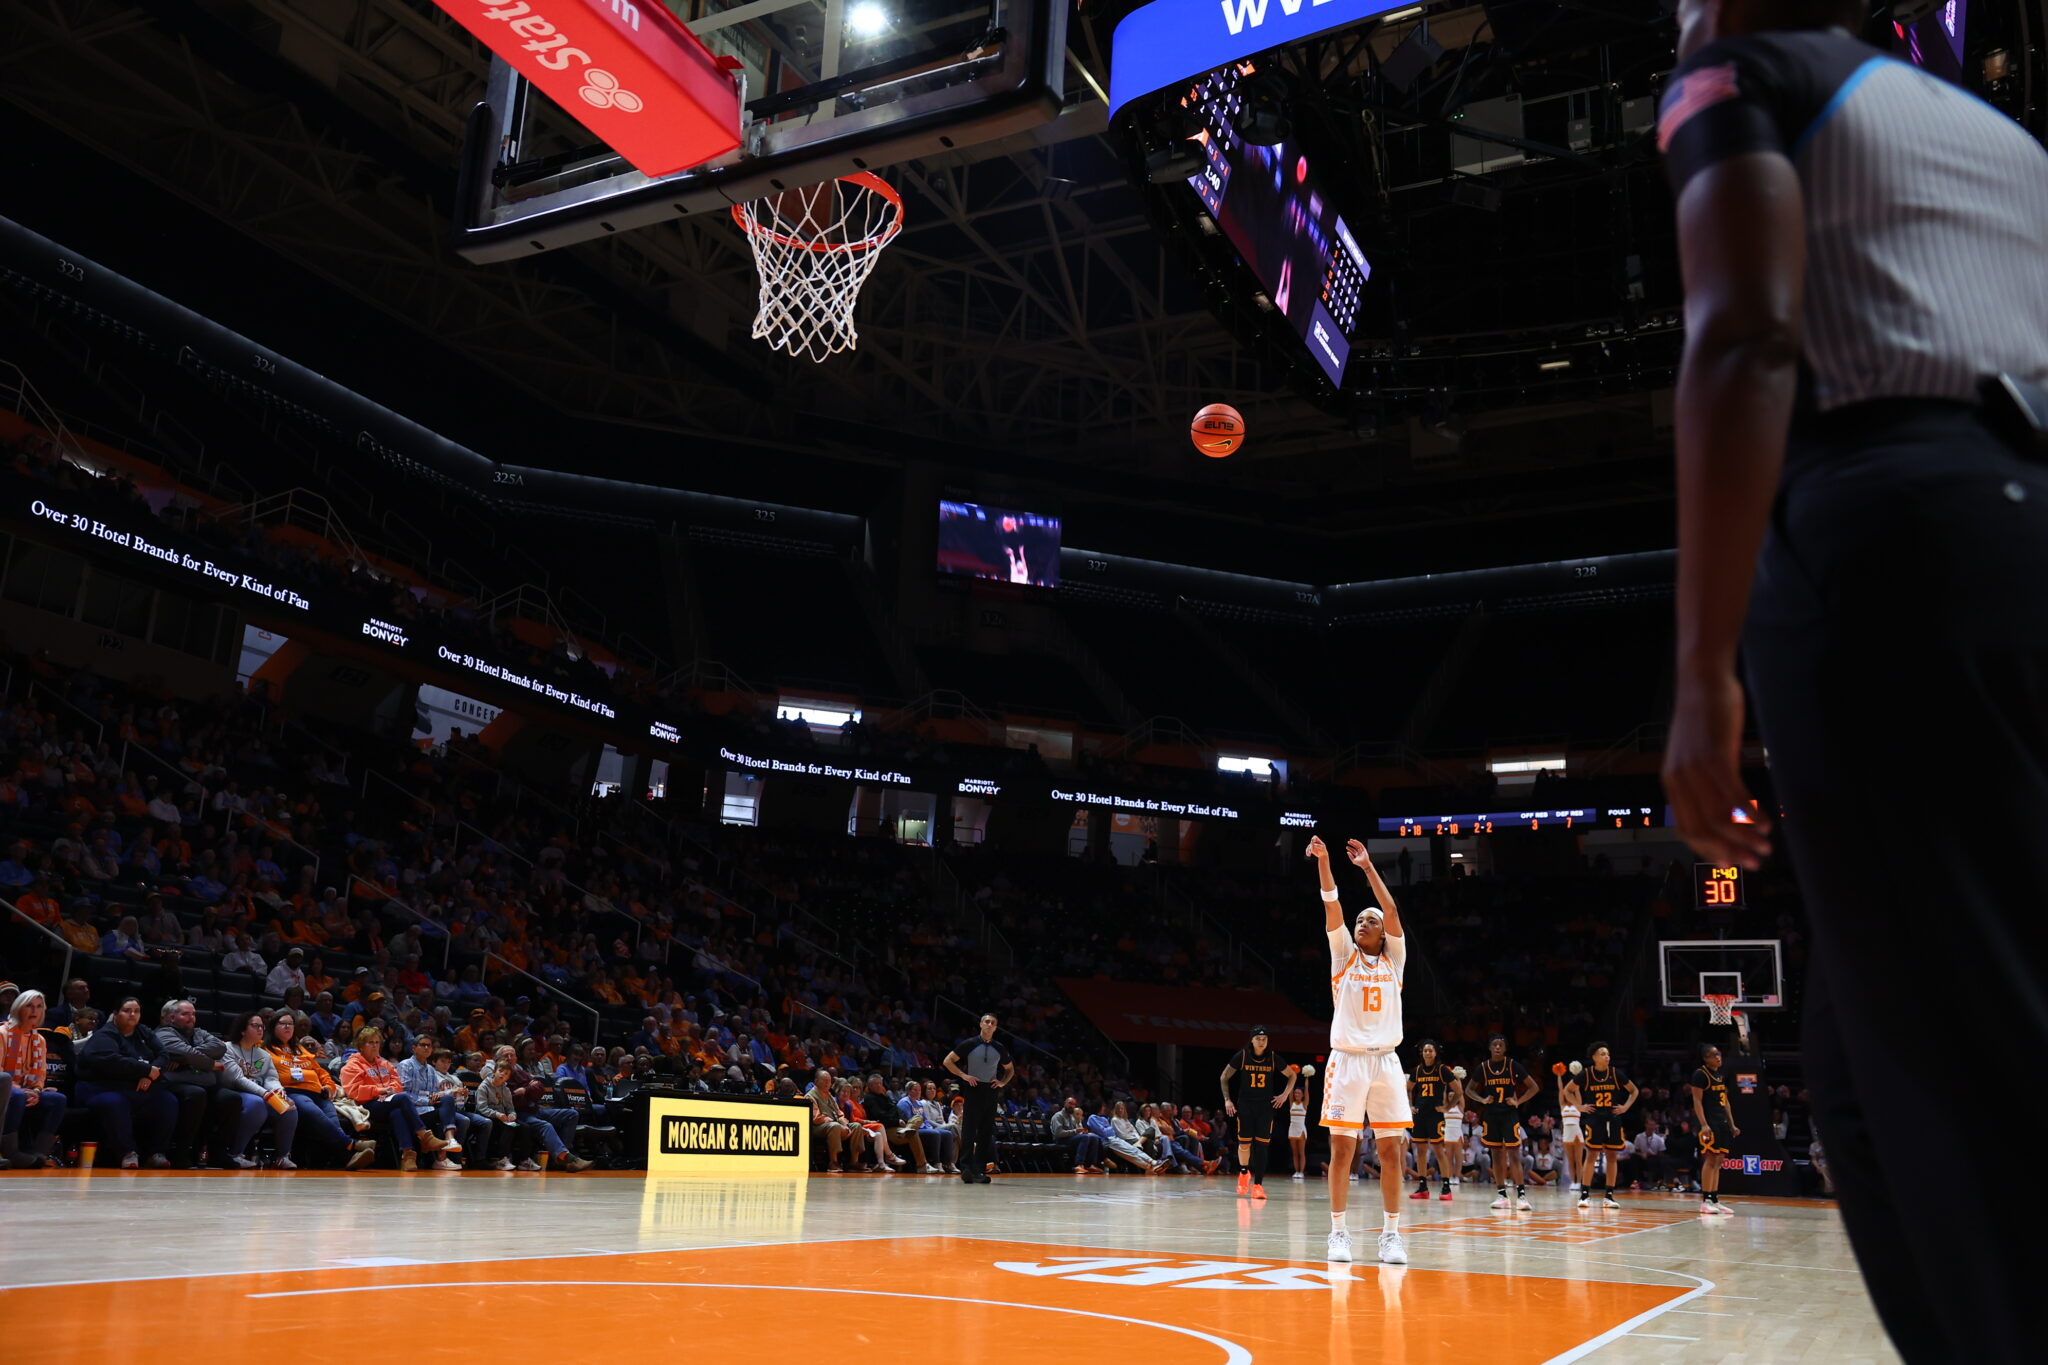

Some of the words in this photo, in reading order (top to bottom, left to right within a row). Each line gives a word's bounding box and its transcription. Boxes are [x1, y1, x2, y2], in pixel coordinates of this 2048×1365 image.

[1205, 165, 1220, 191] 1:40
[57, 258, 84, 281] 323
[253, 354, 276, 375] 324
[493, 471, 525, 487] 325A
[754, 508, 776, 522] 325
[31, 500, 68, 524] Over
[70, 514, 88, 531] 30
[91, 520, 130, 547] Hotel
[133, 535, 180, 564] Brands
[181, 554, 201, 571] for
[202, 561, 239, 587] Every
[241, 574, 272, 597] Kind
[274, 589, 288, 601] of
[288, 591, 309, 610] Fan
[1087, 559, 1107, 573] 327
[1575, 566, 1597, 579] 328
[370, 617, 403, 634] MARRIOTT
[362, 623, 409, 647] BONVOY
[438, 646, 461, 664] Over
[462, 654, 474, 668] 30
[474, 659, 500, 678] Hotel
[501, 668, 531, 689] Brands
[532, 679, 545, 694] for
[545, 684, 569, 704] Every
[570, 693, 590, 710] Kind
[591, 702, 600, 713] of
[600, 702, 615, 719] Fan
[650, 725, 682, 743] BONVOY
[655, 721, 677, 733] MARRIOTT
[720, 747, 736, 762] Over
[736, 754, 744, 764] 30
[745, 756, 769, 769] Hotel
[772, 760, 806, 773] Brands
[808, 764, 822, 775] for
[824, 766, 852, 780] Every
[855, 769, 879, 781] Kind
[881, 771, 892, 782] of
[893, 773, 911, 784] Fan
[958, 783, 1000, 795] BONVOY
[964, 778, 994, 786] MARRIOTT
[1051, 789, 1073, 801] Over
[1075, 792, 1086, 802] 30
[1087, 793, 1113, 806] Hotel
[1114, 796, 1145, 809] Brands
[1146, 799, 1160, 811] for
[1161, 802, 1186, 815] Every
[1188, 804, 1210, 816] Kind
[1211, 806, 1222, 817] of
[1222, 808, 1238, 819] Fan
[1608, 808, 1631, 816] FOULS
[1279, 817, 1317, 828] BONVOY
[1532, 819, 1538, 831] 3
[1566, 817, 1572, 828] 7
[1616, 818, 1622, 828] 5
[1643, 816, 1649, 826] 4
[1712, 867, 1738, 880] 1:40
[1705, 880, 1736, 904] 30
[1349, 973, 1393, 983] TENNSSEE
[1362, 986, 1382, 1012] 13
[1250, 1073, 1265, 1088] 13
[1421, 1083, 1434, 1097] 21
[1495, 1087, 1504, 1103] 7
[1595, 1092, 1612, 1107] 22
[668, 1121, 725, 1149] MORGAN
[729, 1124, 738, 1150] &
[742, 1125, 794, 1151] MORGAN
[1721, 1158, 1744, 1169] OOD
[1760, 1159, 1783, 1171] CITY
